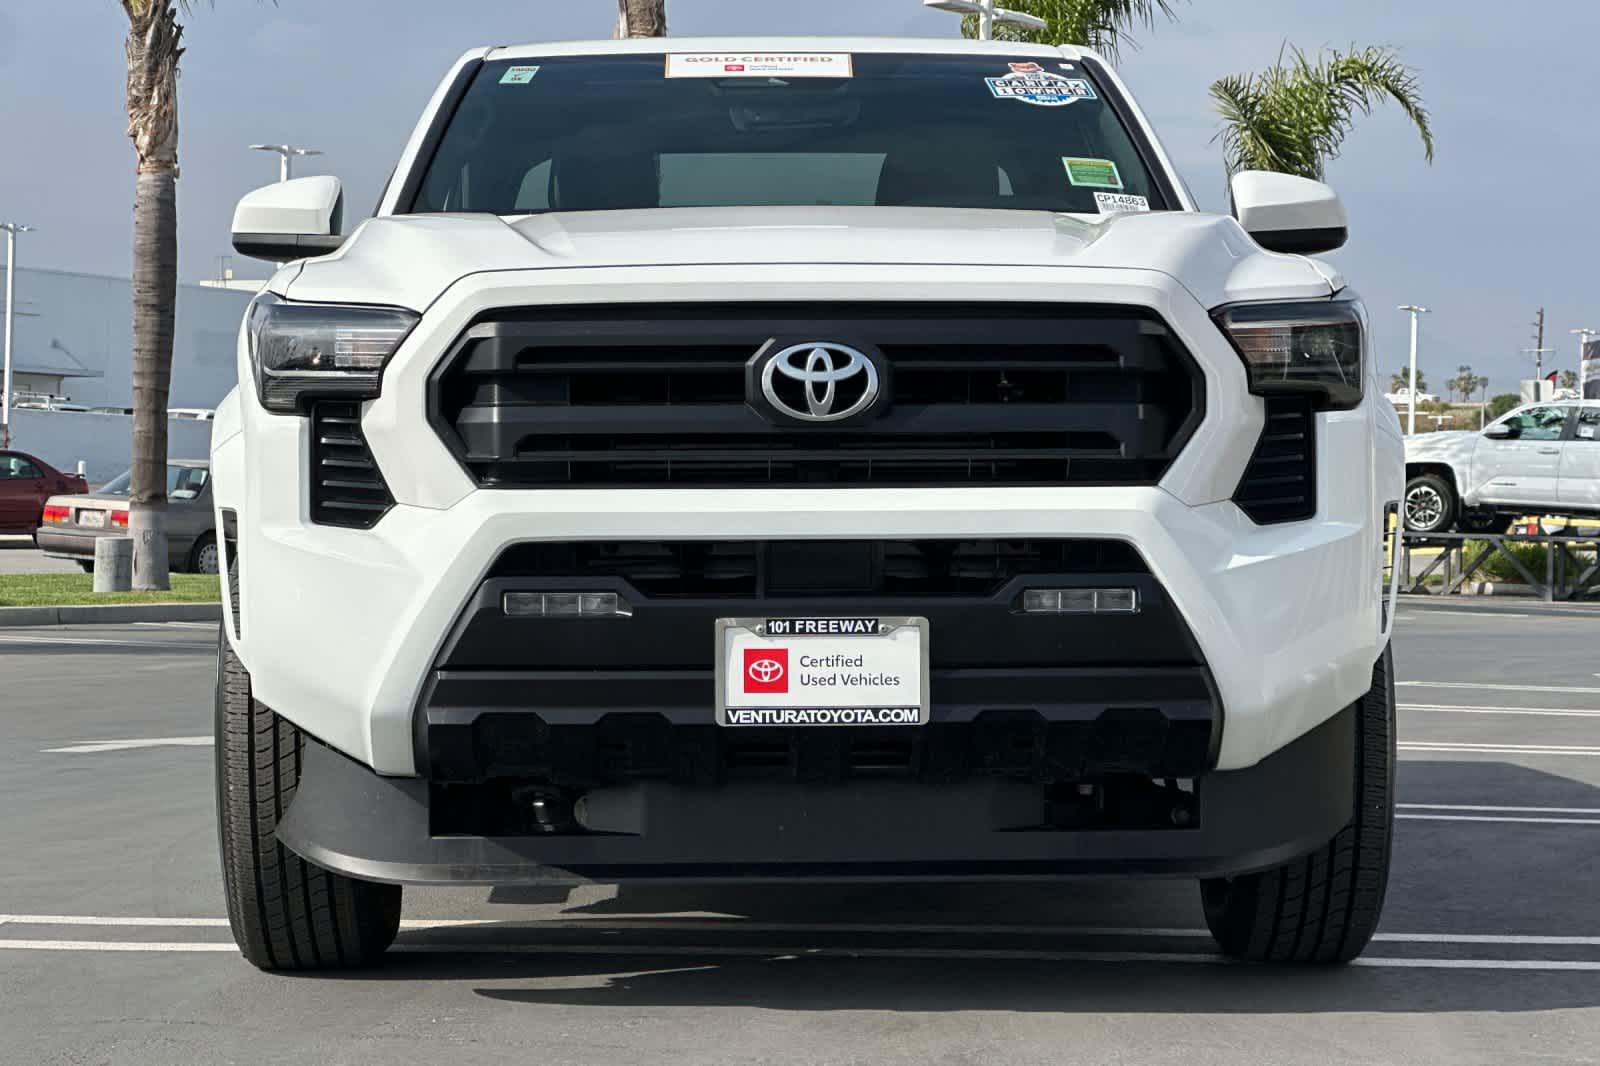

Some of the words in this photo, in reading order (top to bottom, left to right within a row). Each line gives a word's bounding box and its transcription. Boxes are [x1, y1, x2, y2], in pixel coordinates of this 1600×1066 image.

[993, 80, 1081, 88] CARFAX
[1097, 194, 1146, 206] CP14863
[768, 621, 790, 633] 101
[796, 620, 875, 633] FREEWAY
[800, 655, 863, 668] Certified
[800, 674, 836, 686] Used
[841, 674, 900, 686] Vehicles
[728, 709, 919, 723] VENTURATOYOTA.COM
